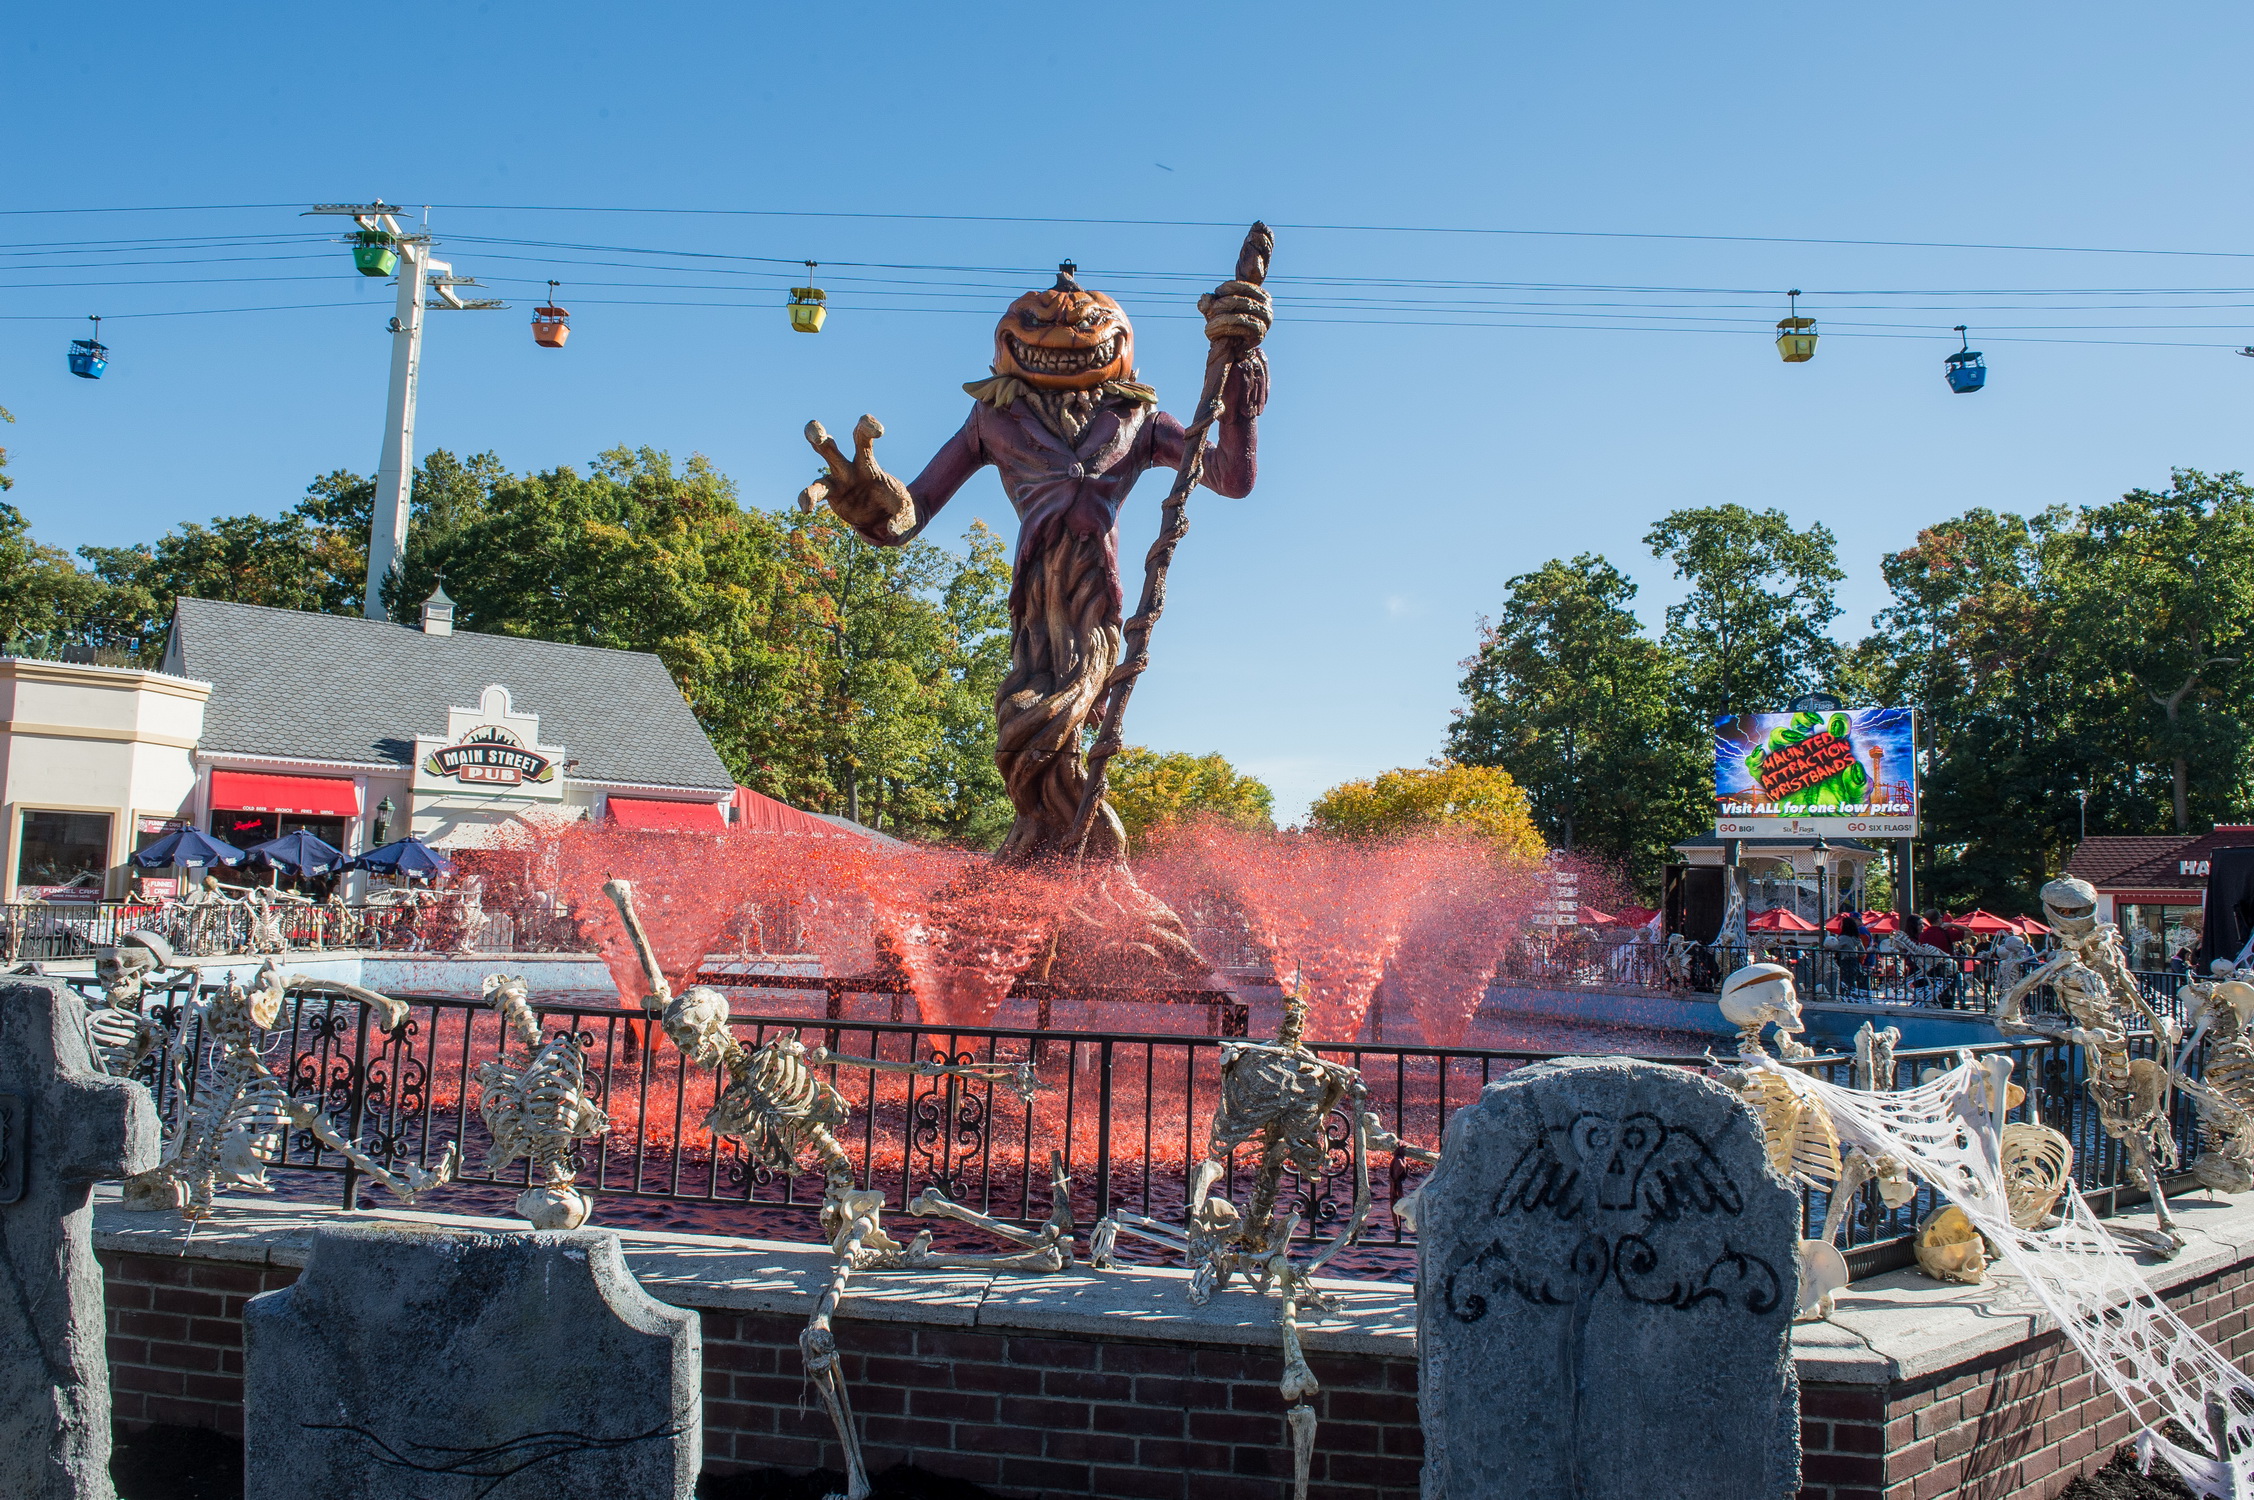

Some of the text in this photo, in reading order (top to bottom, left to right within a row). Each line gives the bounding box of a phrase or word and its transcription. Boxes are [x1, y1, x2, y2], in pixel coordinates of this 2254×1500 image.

[444, 749, 539, 773] MAIN STREET
[1762, 731, 1835, 771] HAUNTED
[468, 767, 516, 781] PUB
[1761, 741, 1851, 789] ATTRACTION
[1766, 752, 1856, 803] WRISTBANDS
[1721, 800, 1910, 816] Visit ALL for one low price
[1720, 823, 1737, 832] GO
[1848, 822, 1866, 832] GO
